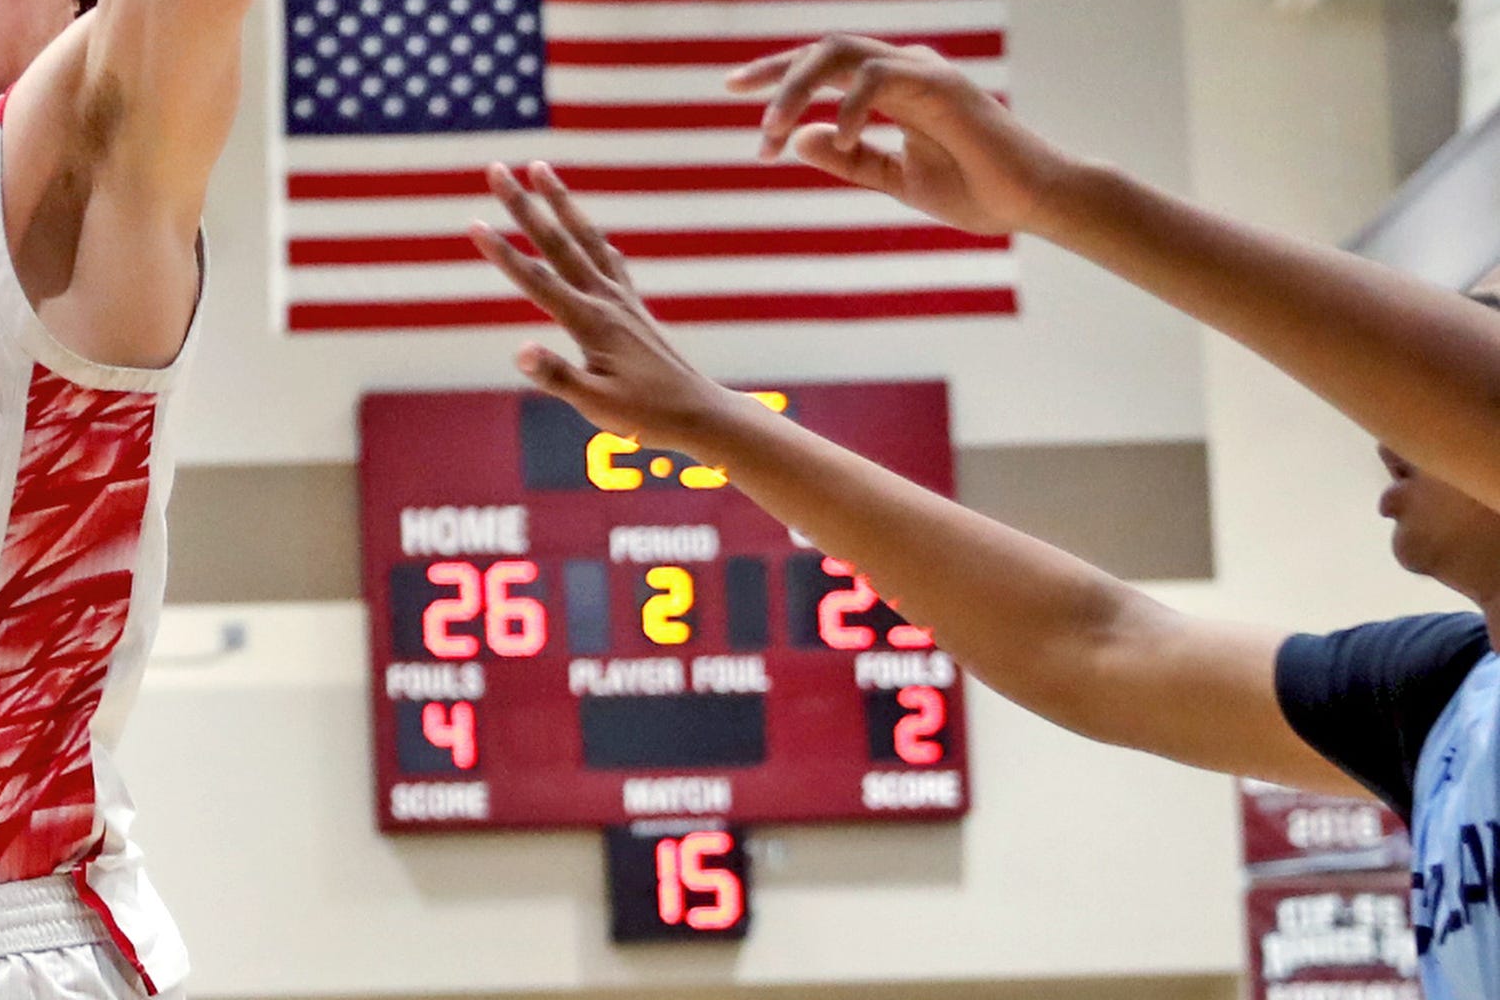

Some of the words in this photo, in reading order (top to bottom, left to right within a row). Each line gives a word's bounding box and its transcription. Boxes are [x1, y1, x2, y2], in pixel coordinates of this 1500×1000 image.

[400, 505, 531, 556] HOME
[609, 524, 720, 564] PERIOD
[422, 560, 548, 659] 26
[642, 566, 695, 645] 2
[816, 555, 938, 650] 2
[386, 662, 486, 700] FOULS
[568, 658, 686, 697] PLAYER
[690, 655, 772, 693] FOUL
[855, 650, 956, 690] FOULS
[421, 701, 478, 769] 4
[892, 685, 948, 765] 2
[391, 782, 490, 821] SCORE
[623, 776, 733, 815] MATCH
[861, 769, 962, 810] SCORE
[655, 831, 747, 931] 15
